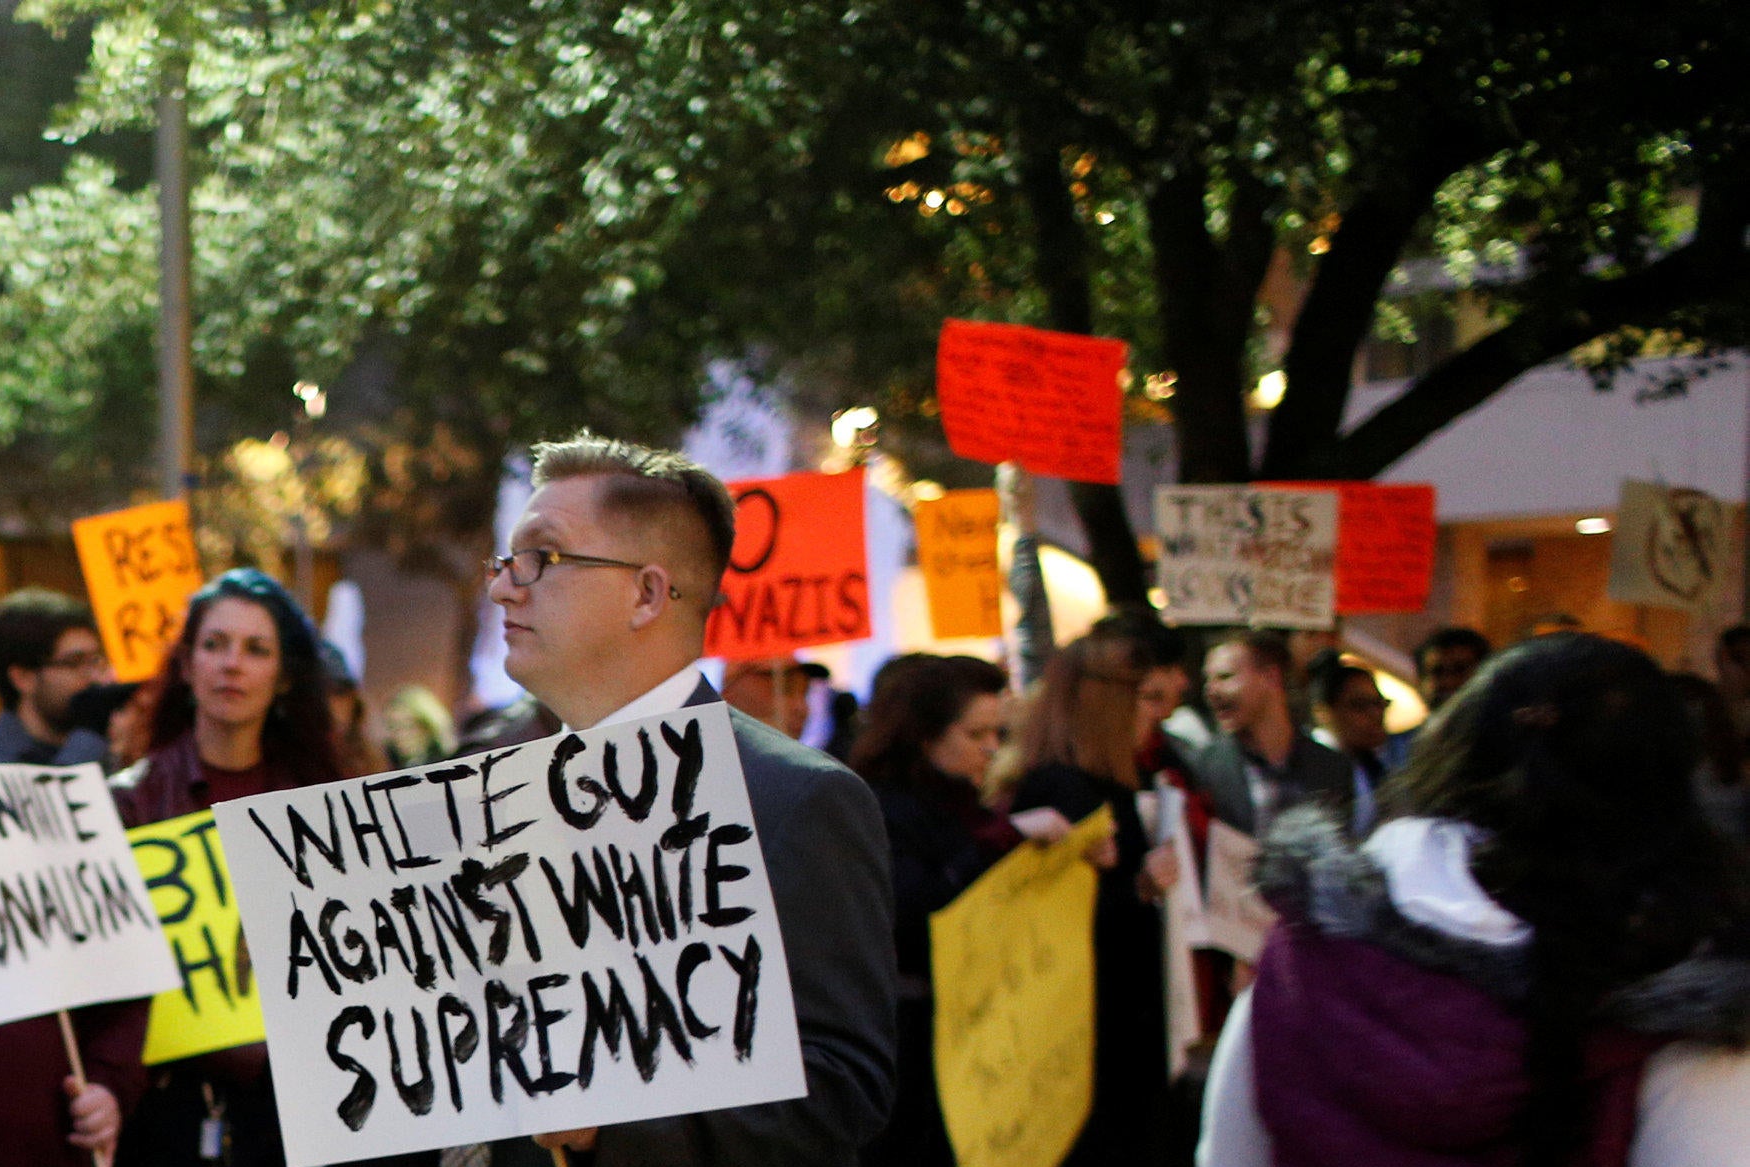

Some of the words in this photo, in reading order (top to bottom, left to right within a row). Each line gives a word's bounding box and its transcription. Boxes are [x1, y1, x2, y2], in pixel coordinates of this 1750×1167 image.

[706, 569, 866, 647] NAZIS
[730, 488, 780, 574] O
[248, 746, 540, 889] WHITE
[549, 718, 705, 831] GUY
[286, 853, 542, 999] AGAINST
[540, 812, 757, 951] WHITE
[325, 935, 763, 1132] SUPREMACY
